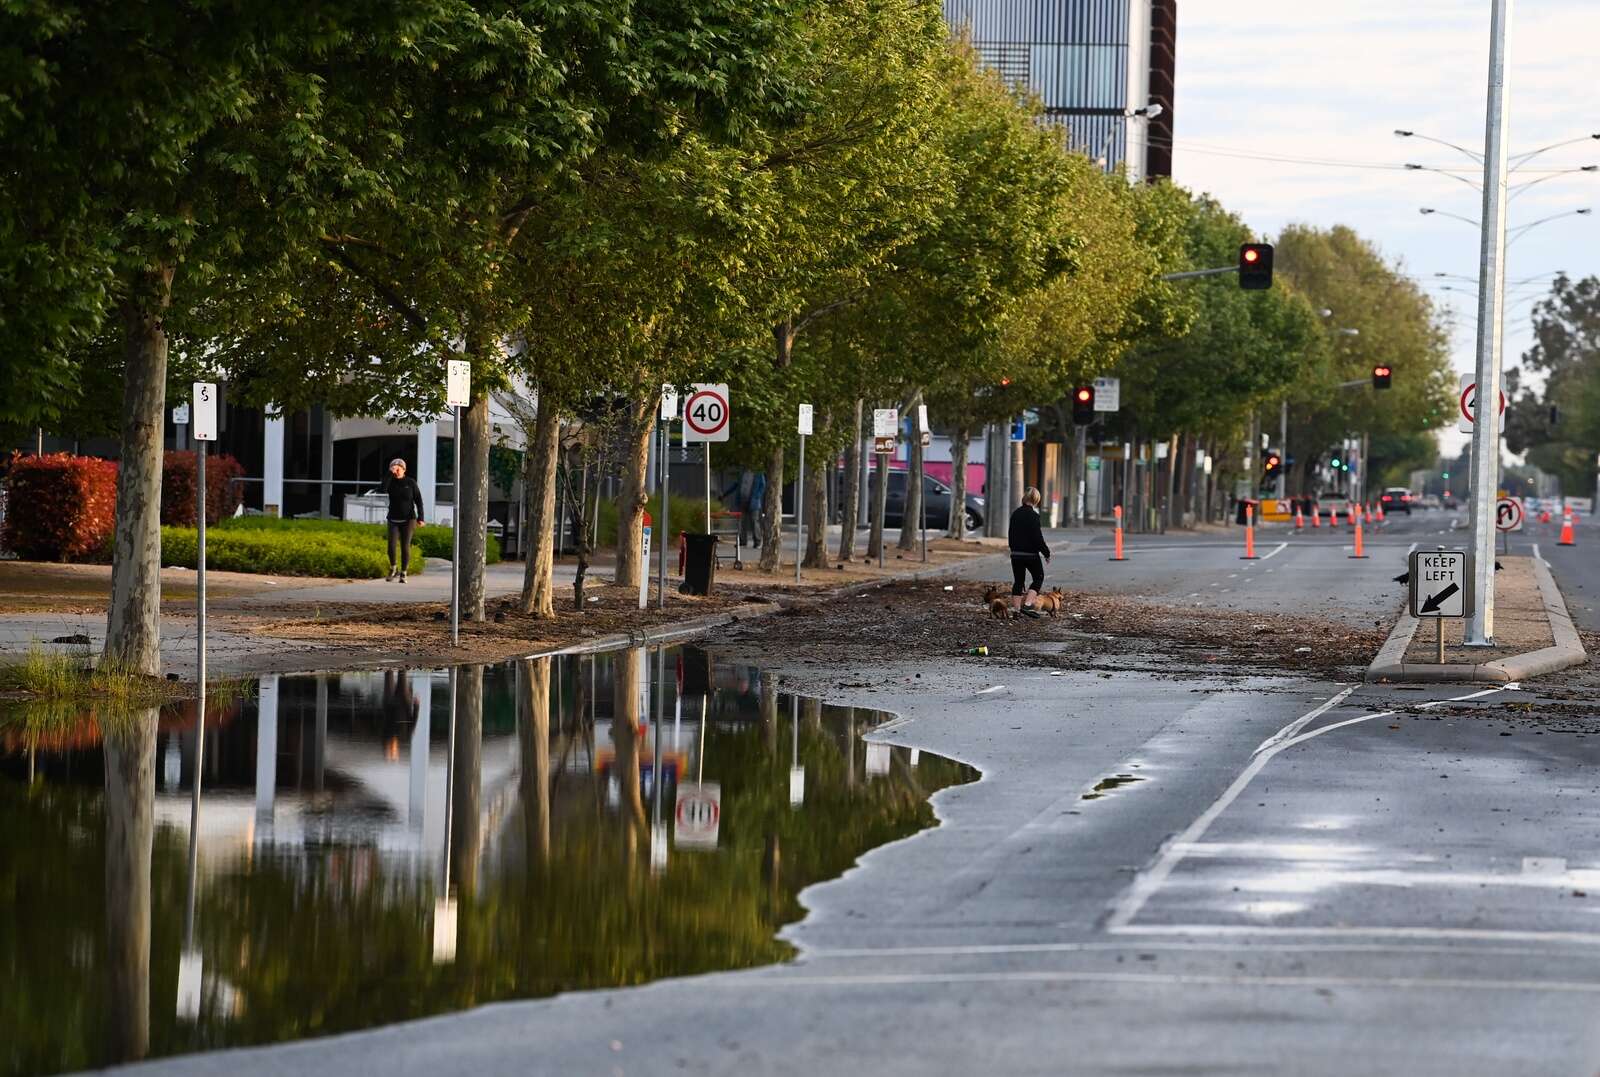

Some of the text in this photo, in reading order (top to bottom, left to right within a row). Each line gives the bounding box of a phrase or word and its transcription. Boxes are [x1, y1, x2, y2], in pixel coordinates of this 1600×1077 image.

[692, 403, 721, 422] 40
[1424, 557, 1456, 568] KEEP
[1425, 570, 1455, 581] LEFT
